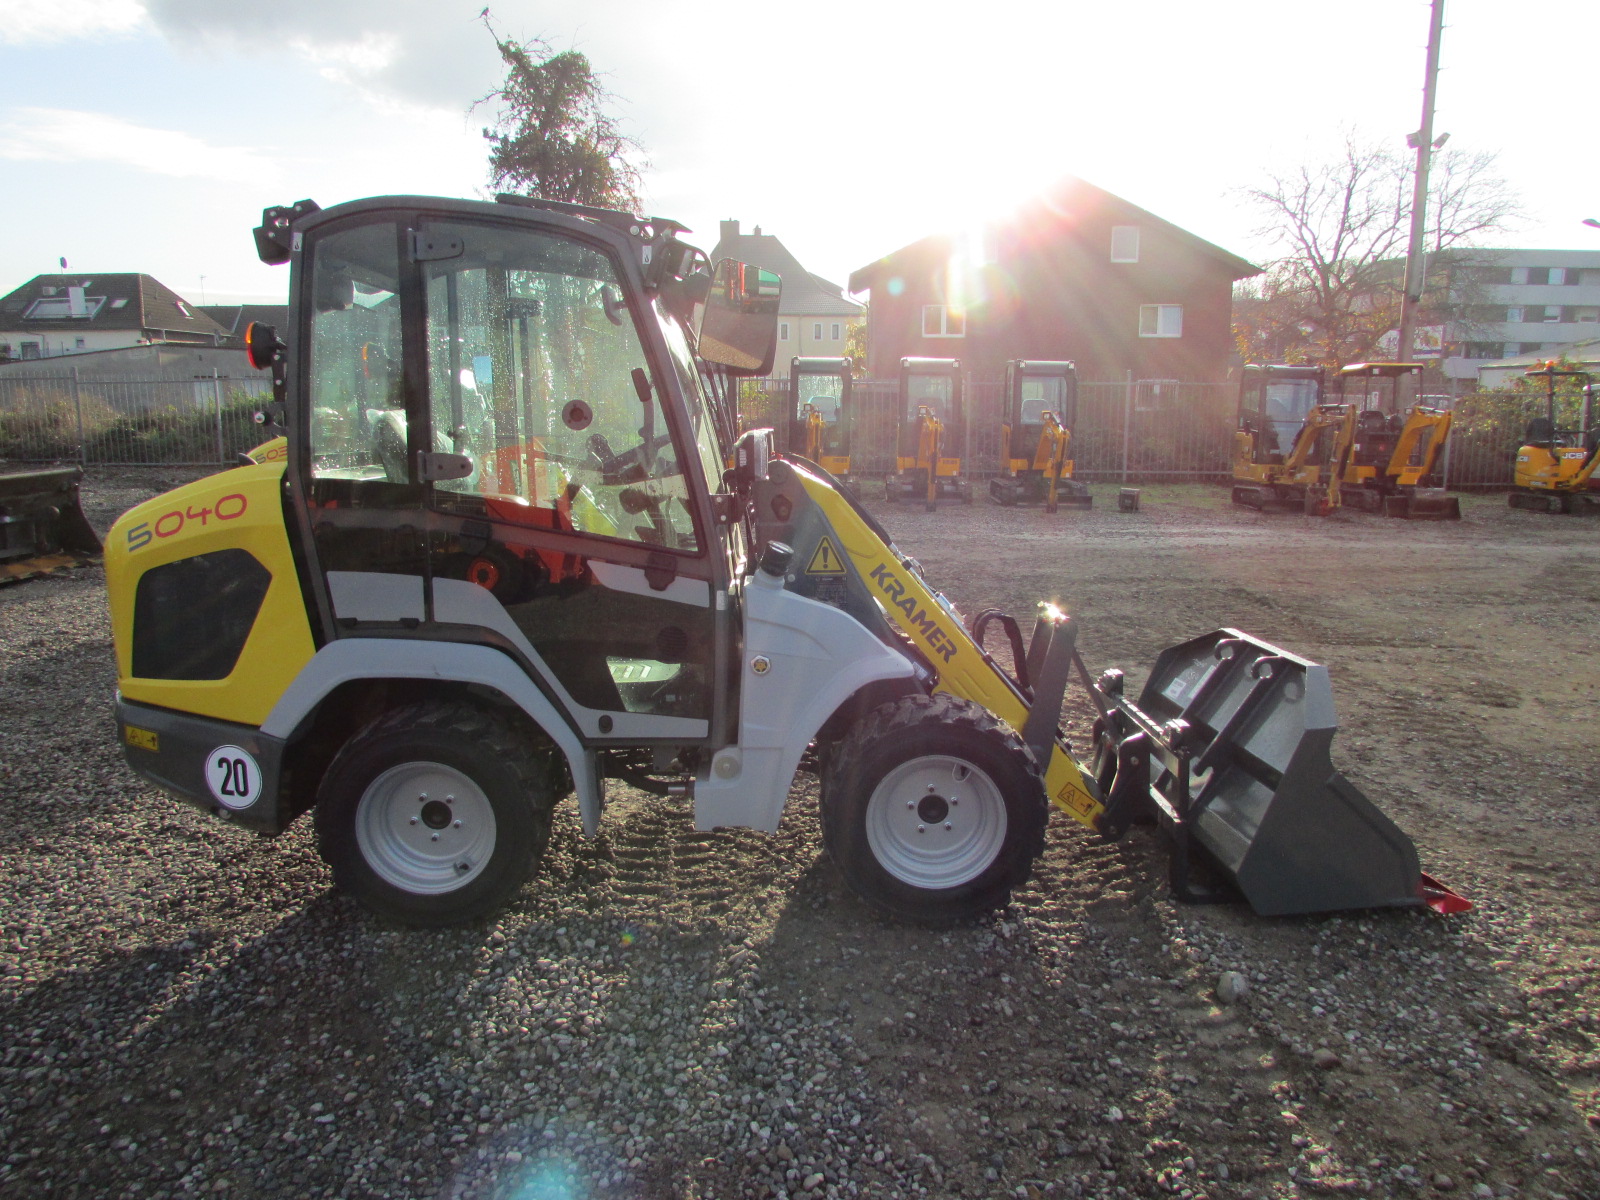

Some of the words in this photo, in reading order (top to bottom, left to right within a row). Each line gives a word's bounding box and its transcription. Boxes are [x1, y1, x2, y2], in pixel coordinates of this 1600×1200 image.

[127, 493, 248, 553] 5040
[869, 562, 958, 664] KRAMER
[217, 757, 250, 797] 20
